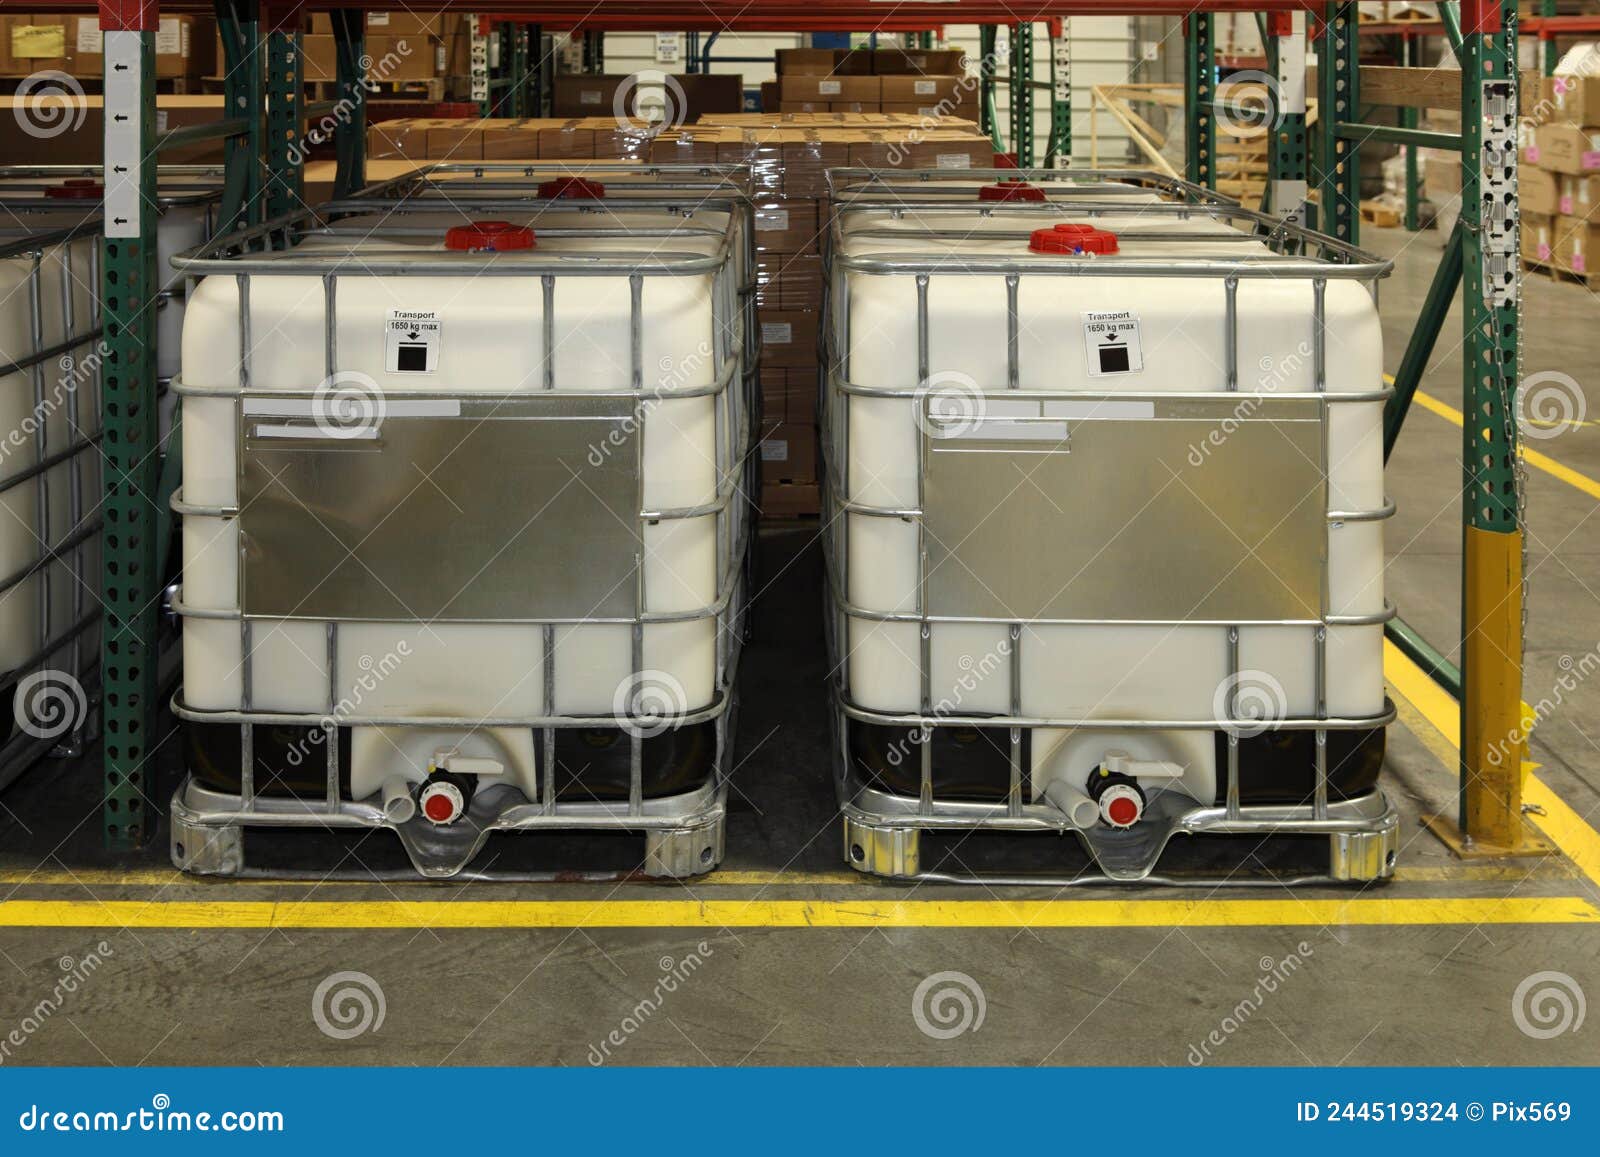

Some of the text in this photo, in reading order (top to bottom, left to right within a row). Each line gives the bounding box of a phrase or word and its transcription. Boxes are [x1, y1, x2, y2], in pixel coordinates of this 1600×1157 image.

[393, 310, 435, 319] Transport
[1087, 311, 1130, 321] Transport
[391, 321, 409, 330] 1650
[410, 322, 420, 332] kg
[1087, 323, 1105, 332] 1650
[1107, 323, 1117, 333] kg
